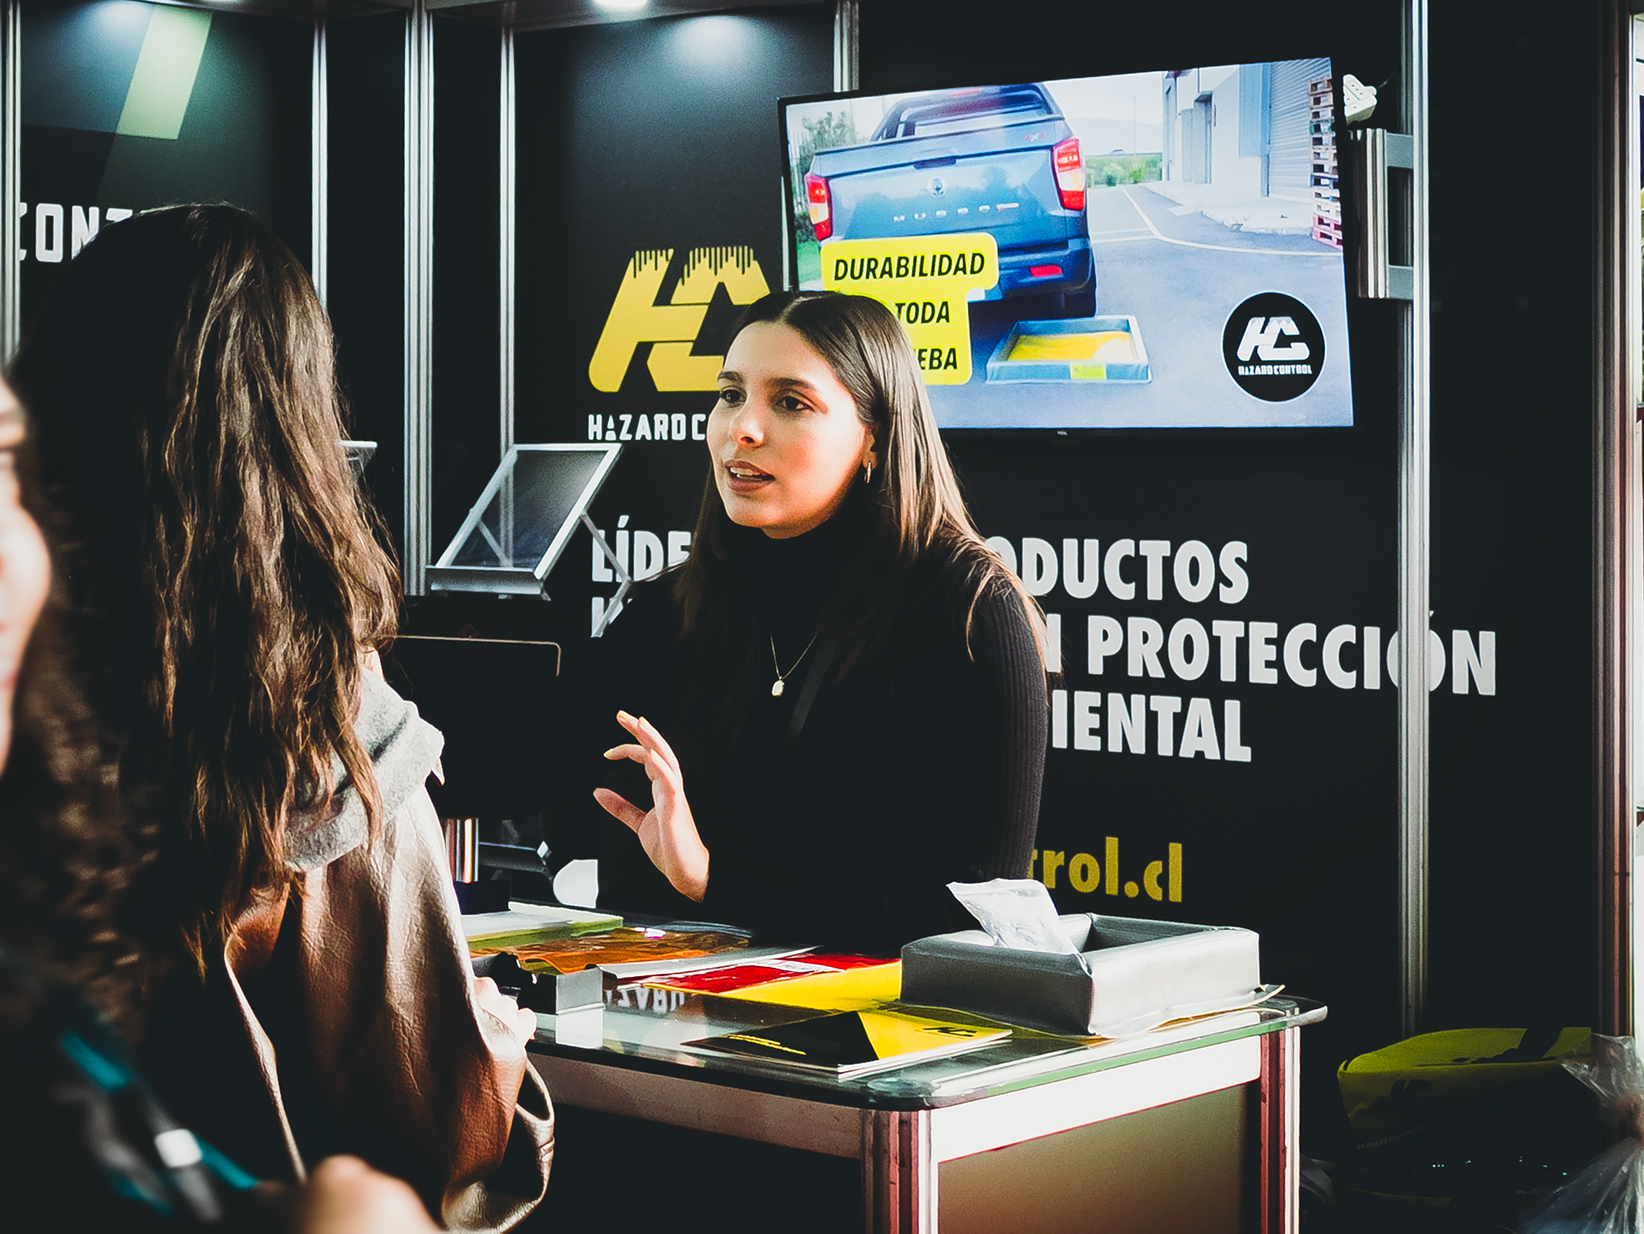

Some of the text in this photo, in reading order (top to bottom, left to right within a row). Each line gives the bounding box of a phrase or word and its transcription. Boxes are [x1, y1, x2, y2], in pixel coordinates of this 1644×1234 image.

[834, 252, 985, 281] DURABILIDAD
[1237, 316, 1310, 361] HC
[914, 347, 957, 370] EBA
